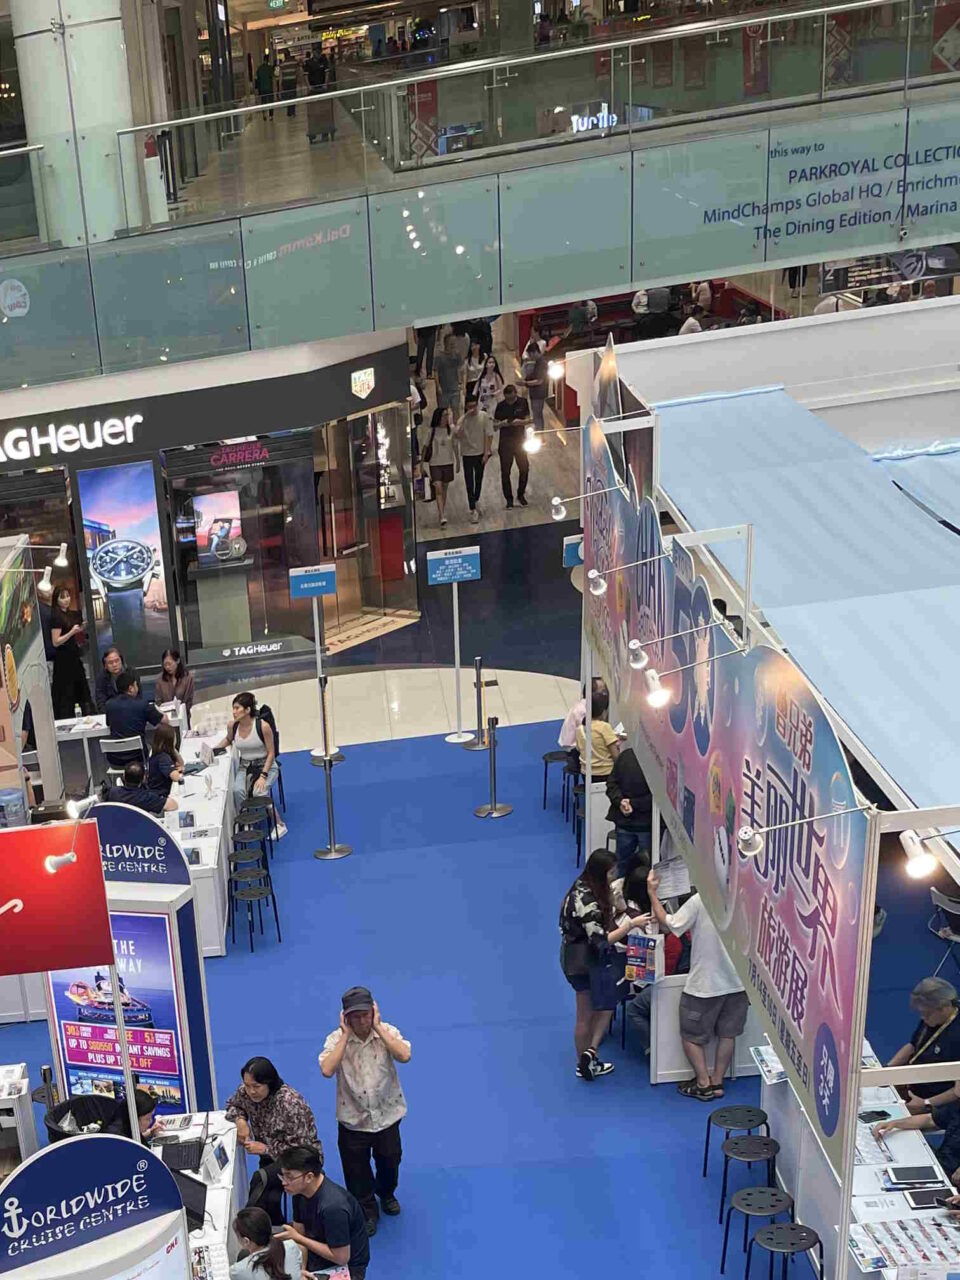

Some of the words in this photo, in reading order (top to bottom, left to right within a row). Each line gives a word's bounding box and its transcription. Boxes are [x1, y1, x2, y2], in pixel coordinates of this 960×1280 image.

[770, 148, 789, 159] this
[791, 145, 812, 157] way
[814, 142, 825, 152] to
[789, 157, 880, 184] PARKROYAL
[703, 197, 802, 224] MindChamps
[806, 186, 855, 208] Global
[859, 182, 883, 200] HQ
[754, 223, 782, 241] The
[786, 215, 835, 236] Dining
[840, 207, 891, 228] Edition
[906, 199, 957, 218] Marina
[210, 448, 269, 466] CARRERA
[118, 862, 167, 873] CENTRE
[68, 1039, 77, 1048] UP
[79, 1040, 87, 1049] TO
[143, 1046, 171, 1057] SAVINGS
[88, 1053, 105, 1063] PLUS
[106, 1054, 115, 1064] UP
[140, 1059, 152, 1068] OFF
[8, 1222, 75, 1256] CRUISE
[80, 1196, 150, 1231] CENTRE
